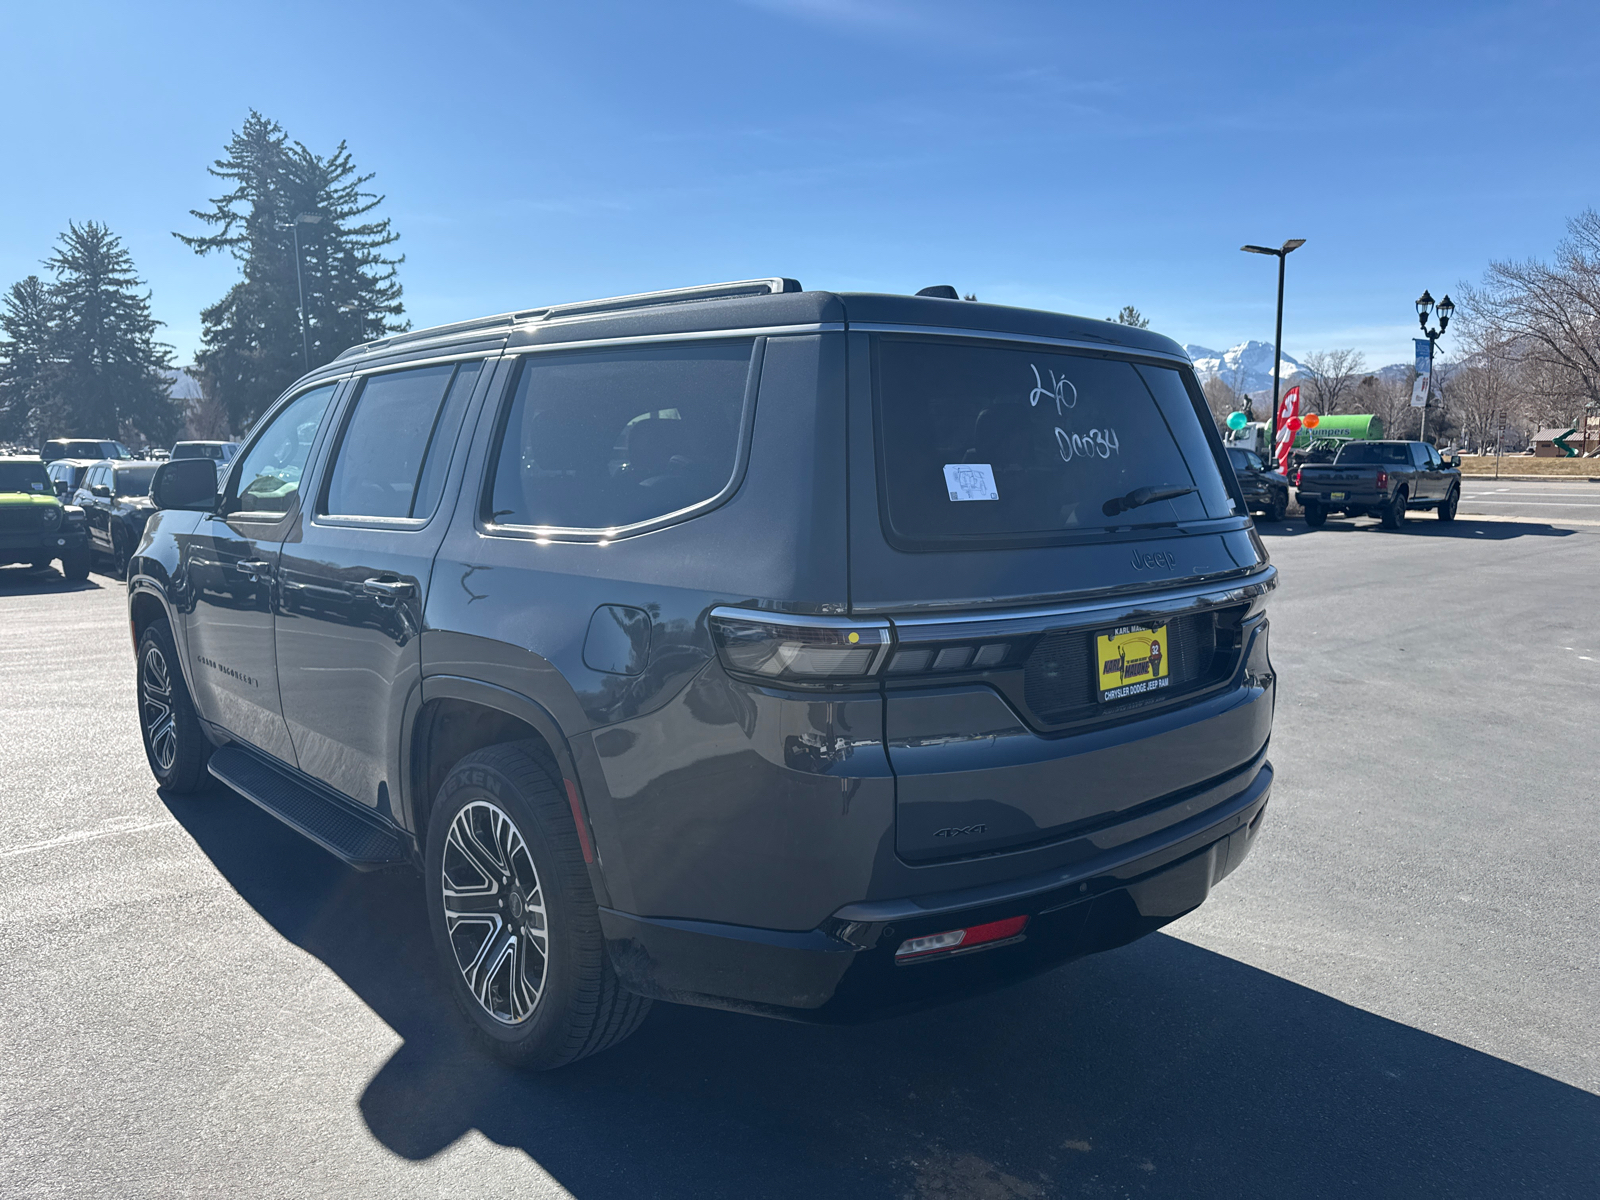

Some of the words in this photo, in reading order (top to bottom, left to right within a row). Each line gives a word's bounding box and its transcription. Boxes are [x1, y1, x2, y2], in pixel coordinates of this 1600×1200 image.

[1130, 549, 1176, 571] Jeep
[1114, 627, 1130, 636] KARL
[1151, 644, 1159, 655] 32
[1103, 658, 1121, 675] KARL
[1124, 661, 1150, 679] MALONE
[1104, 686, 1130, 701] CHRYSLER
[1130, 682, 1147, 695] DODGE
[1147, 680, 1158, 692] JEEP
[1158, 678, 1169, 687] RAM
[436, 769, 502, 808] NEXEN
